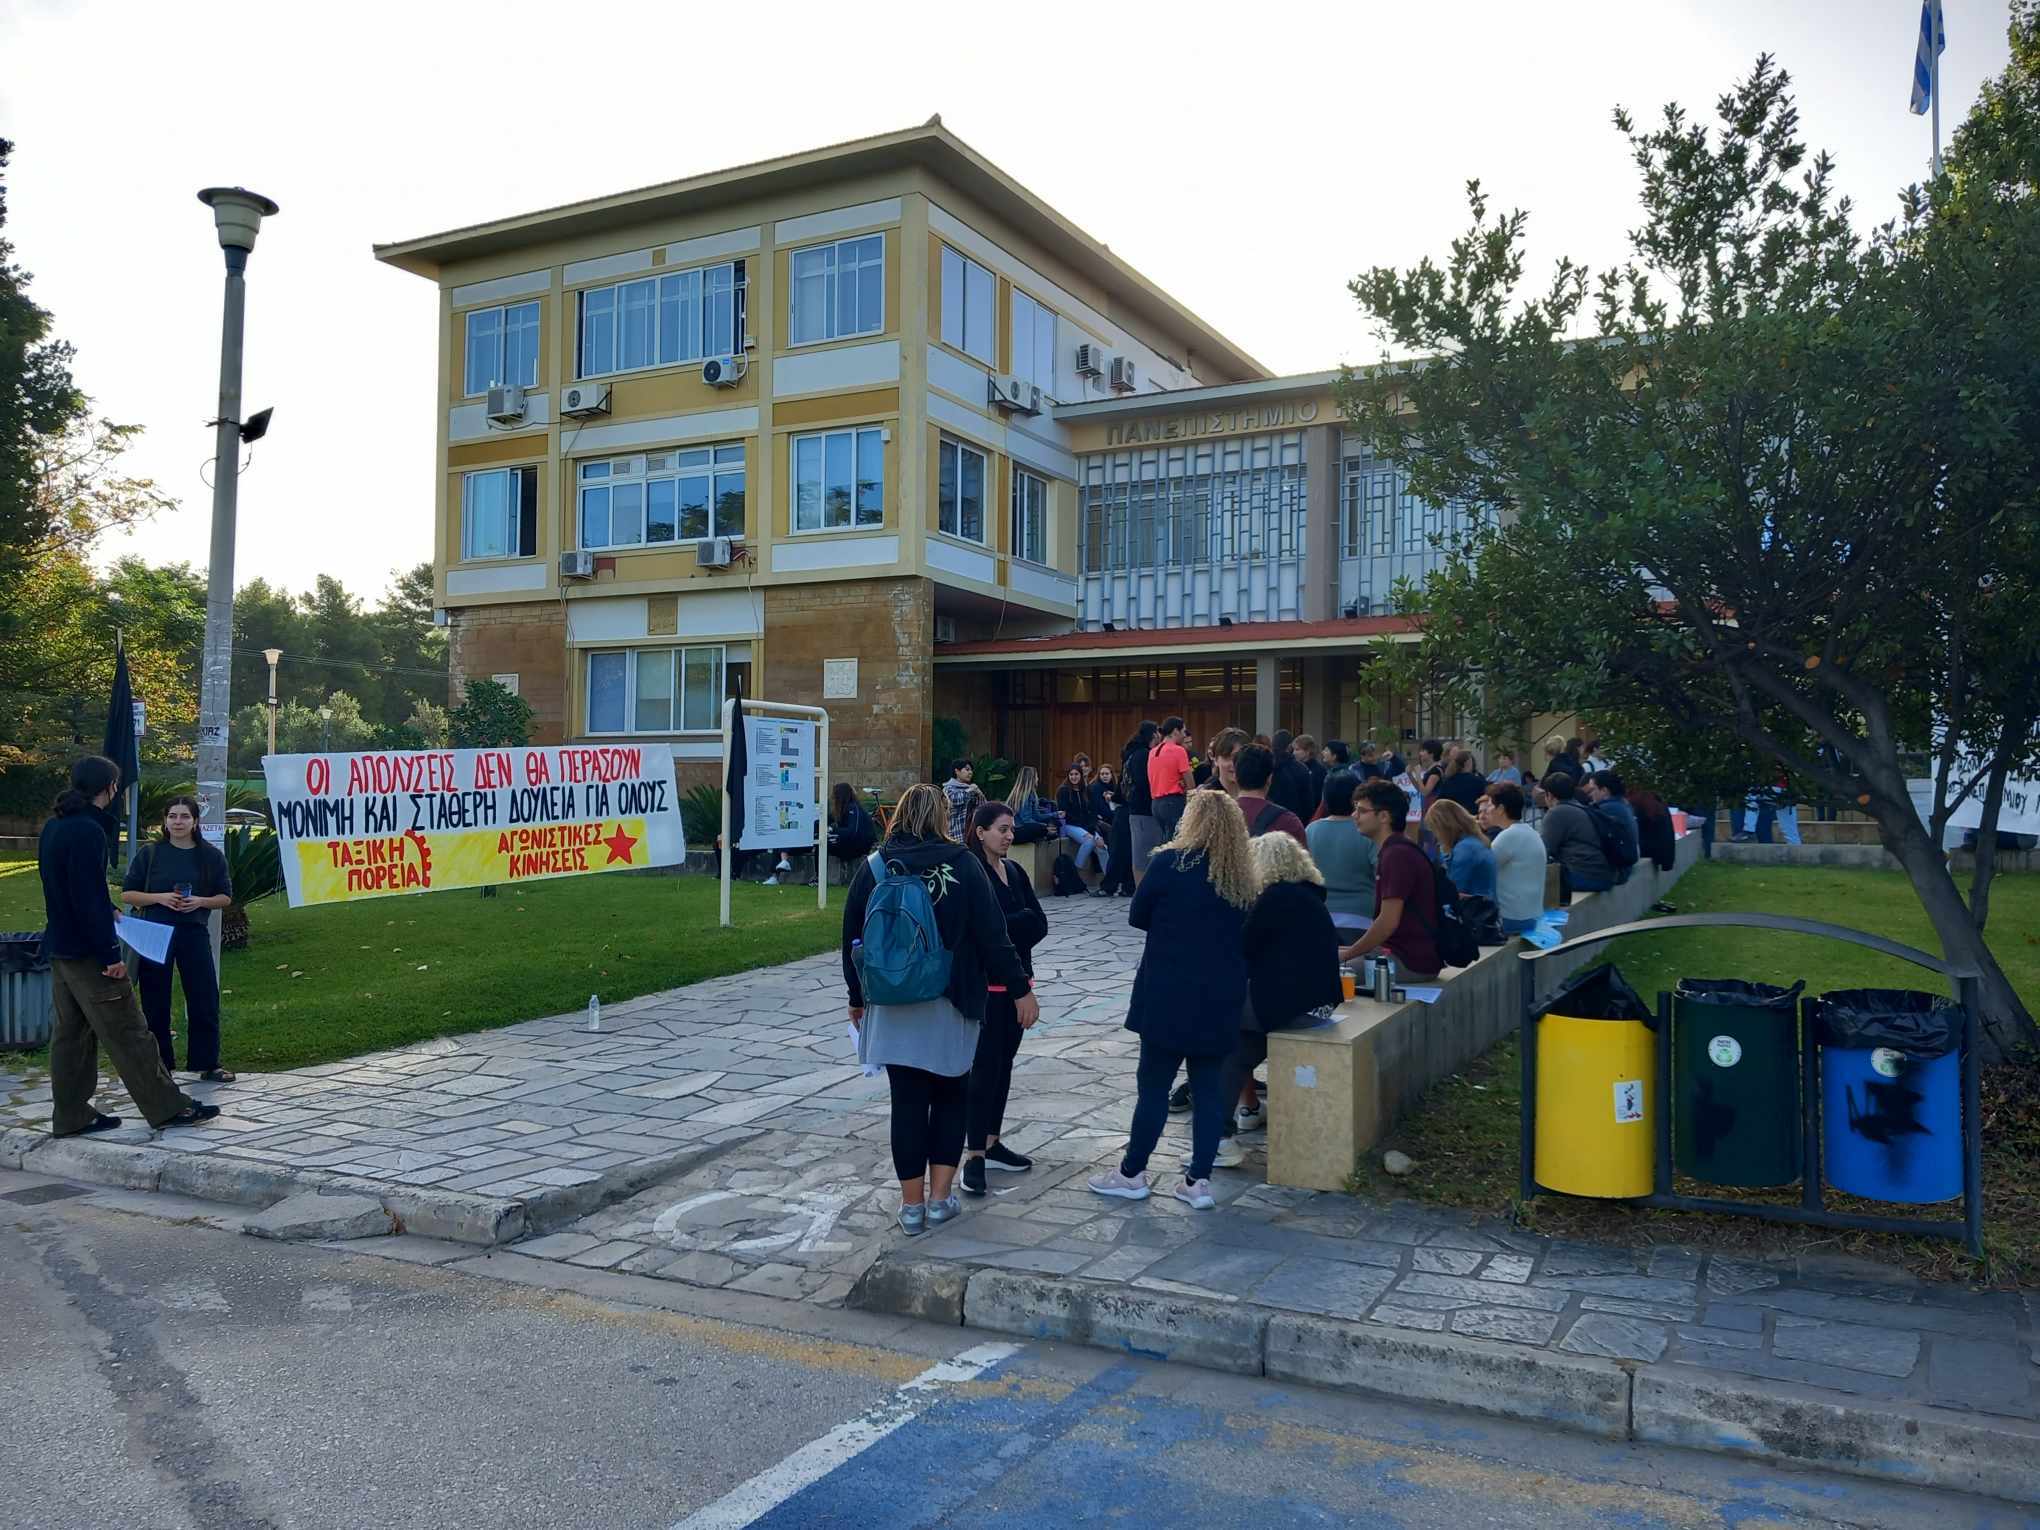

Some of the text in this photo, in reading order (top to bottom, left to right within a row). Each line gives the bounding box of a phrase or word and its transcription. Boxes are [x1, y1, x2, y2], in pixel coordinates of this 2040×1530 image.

[1106, 401, 1319, 446] ΠΑΝΕΠΙΣΤΗΜΙΟ
[306, 748, 641, 797] ΟΙ ΑΠΟΛΥΣΕΙΣ ΔΕΝ ΘΑ ΠΕΡΑΣΟΥΝ
[277, 780, 669, 840] ΜΟΝΙΜΗ ΚΑΙ ΣΤΑΘΕΡΗ ΔΟΥΛΕΙΑ ΓΙΑ ΟΛΟΥΣ
[327, 837, 405, 868] ΤΑΞΙΚΗ
[497, 823, 604, 854] ΑΓΩΝΙΣΤΙΚΕΣ
[347, 862, 421, 892] ΠΟΡΕΙΑ
[508, 846, 589, 879] ΚΙΝΗΣΕΙΣ
